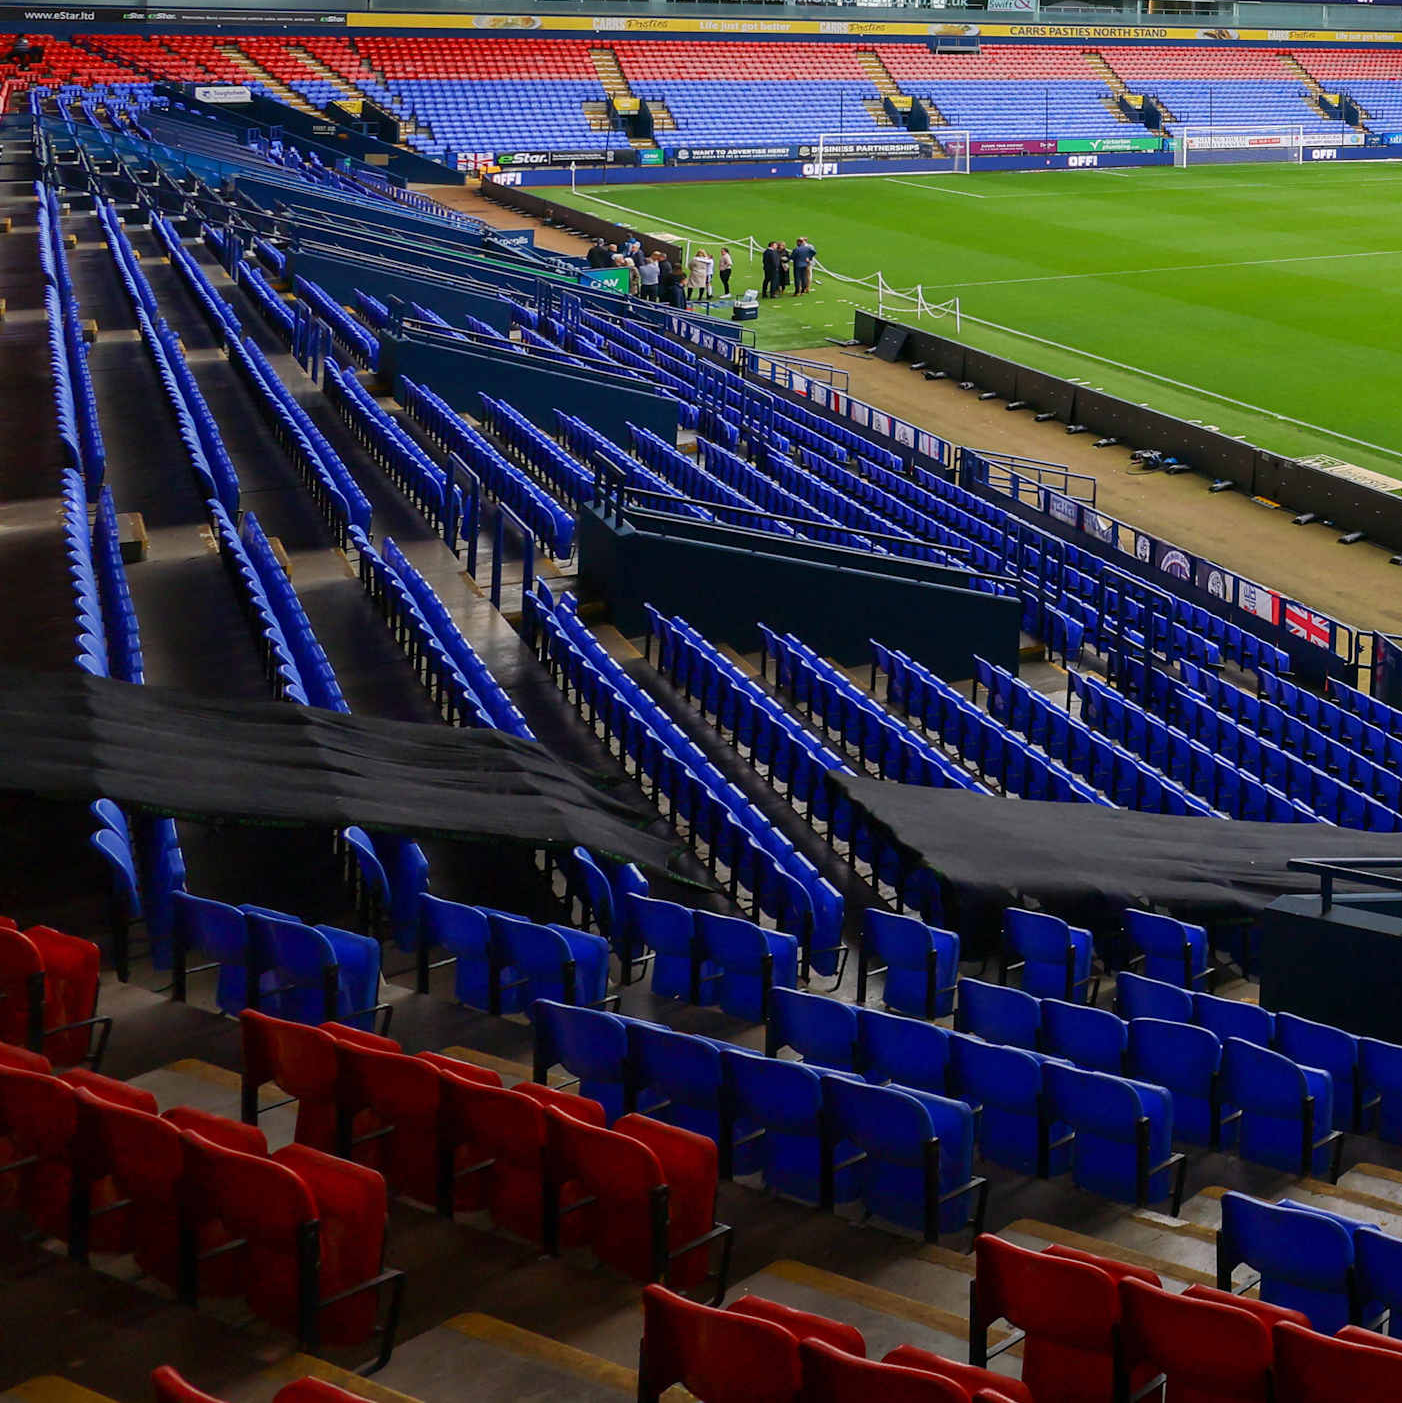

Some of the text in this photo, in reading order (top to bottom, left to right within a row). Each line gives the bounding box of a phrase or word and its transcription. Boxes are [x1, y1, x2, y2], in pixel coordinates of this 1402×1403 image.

[24, 11, 95, 21] www.eStar.ltd
[1010, 26, 1167, 38] CARRS PASTIES NORTH STAND
